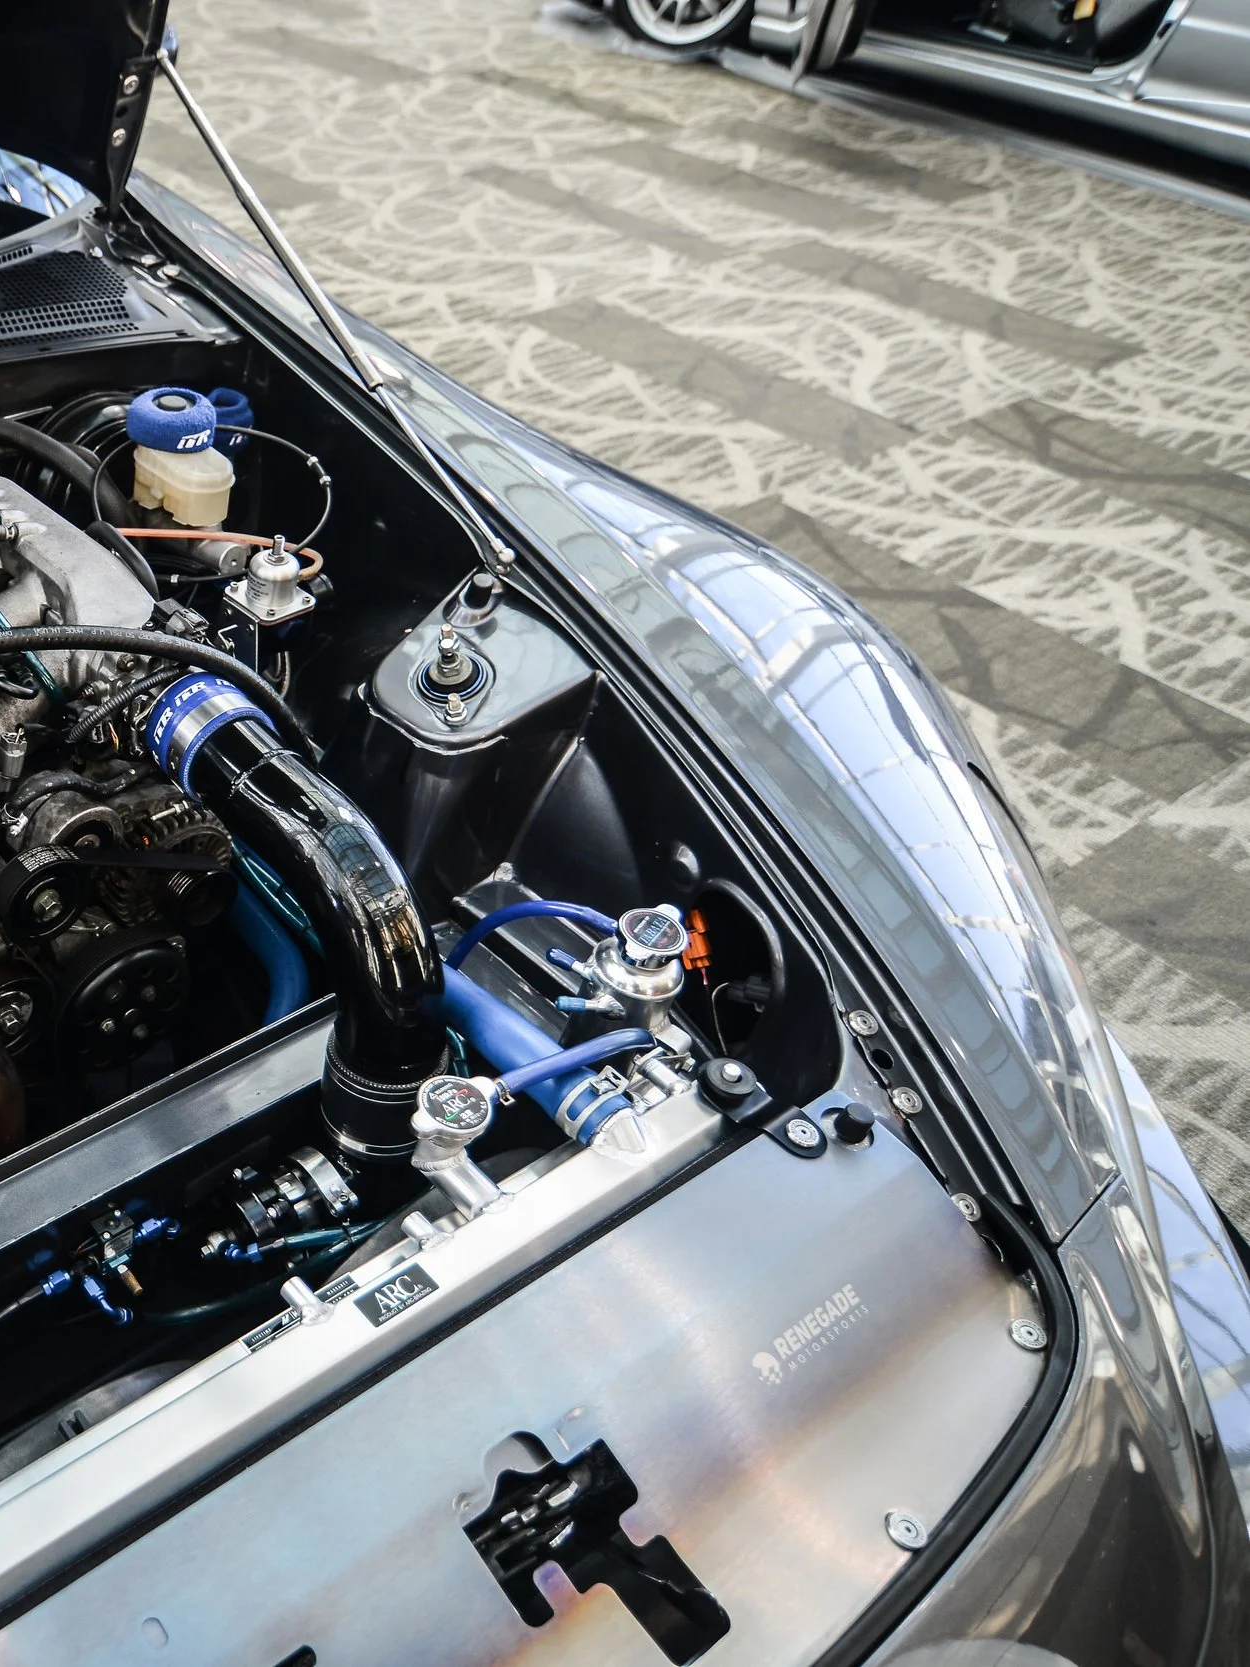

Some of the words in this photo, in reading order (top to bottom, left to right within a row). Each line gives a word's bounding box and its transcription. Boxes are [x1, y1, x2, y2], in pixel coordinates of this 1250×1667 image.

[442, 1093, 470, 1117] ARC
[374, 1275, 421, 1314] ARC
[773, 1283, 861, 1360] RENEGADE
[788, 1304, 869, 1371] MOTORSPORTS
